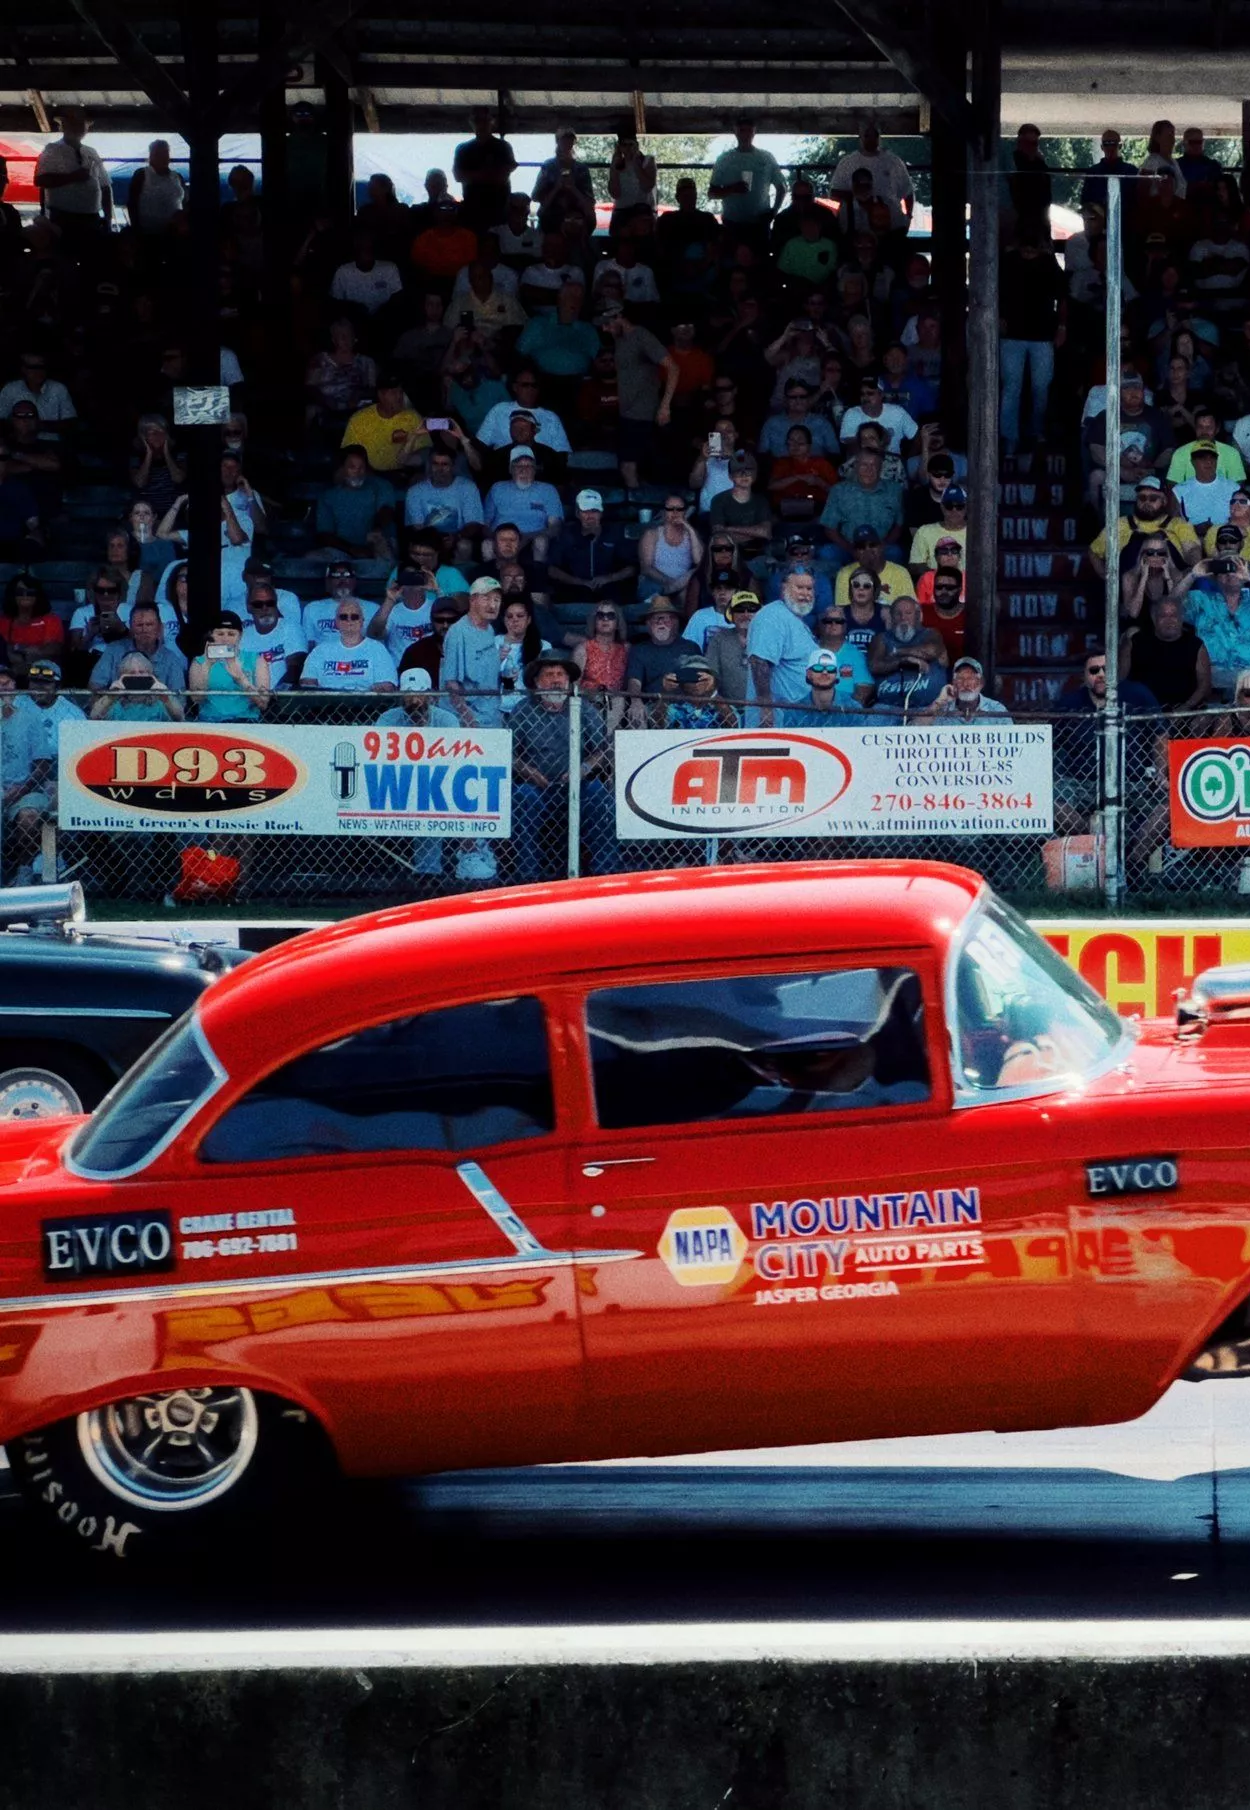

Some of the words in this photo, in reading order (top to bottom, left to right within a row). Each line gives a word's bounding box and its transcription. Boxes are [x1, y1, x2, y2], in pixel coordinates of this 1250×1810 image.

[861, 733, 932, 747] CUSTOM
[936, 732, 982, 746] CARB
[986, 731, 1046, 745] BUILDS
[883, 747, 973, 760] THROTTLE
[977, 746, 1024, 760] STOP/
[111, 746, 268, 785] D93
[365, 764, 507, 813] WKCT
[895, 773, 1014, 787] CONVERSIONS
[671, 804, 805, 815] INNOVATION
[870, 791, 1034, 812] 270-846-3864
[70, 816, 135, 832] Bowling
[139, 817, 200, 831] Green's
[204, 818, 260, 831] Classic
[264, 819, 304, 832] Rock
[339, 819, 367, 831] NEWS
[374, 819, 420, 832] WEATHER
[427, 820, 464, 832] SPORTS
[471, 820, 497, 833] INFO
[826, 815, 1048, 831] www.atminnovation.com
[1086, 1161, 1178, 1194] EVCO
[751, 1187, 982, 1239] MOUNTAIN
[46, 1221, 171, 1269] EVCO
[674, 1226, 735, 1266] NAPA
[753, 1239, 849, 1280] CITY
[854, 1245, 910, 1265] AUTO
[916, 1239, 985, 1260] PARTS
[753, 1286, 818, 1306] JASPER
[820, 1281, 900, 1300] GEORGIA
